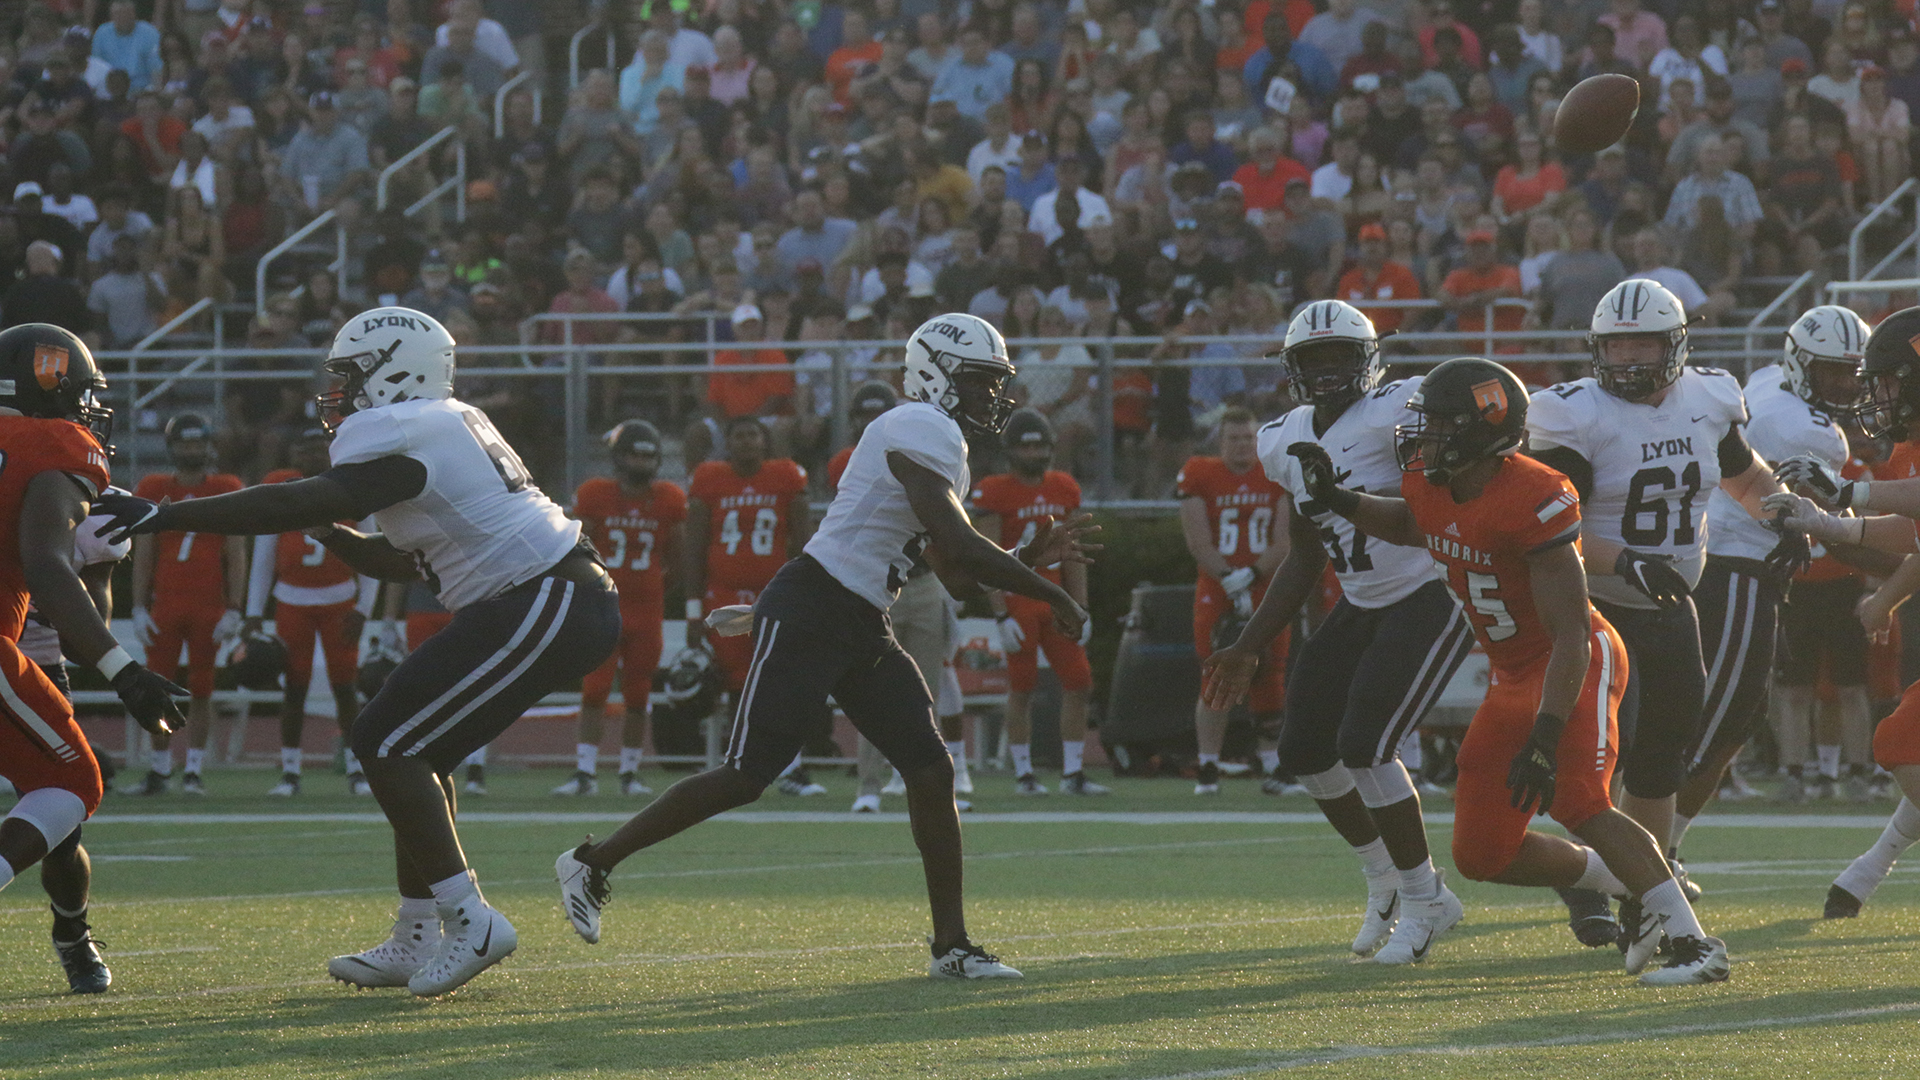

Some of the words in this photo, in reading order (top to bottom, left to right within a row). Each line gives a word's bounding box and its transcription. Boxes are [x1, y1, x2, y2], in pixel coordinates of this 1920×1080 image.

[363, 316, 416, 334] LYON
[921, 322, 966, 344] LYON
[40, 354, 61, 377] H
[1482, 390, 1503, 413] H
[1641, 437, 1694, 463] LYON
[1621, 461, 1701, 547] 61
[720, 508, 778, 556] 48
[1219, 507, 1272, 555] 60
[605, 529, 655, 570] 33
[1425, 533, 1492, 566] HENDRIX
